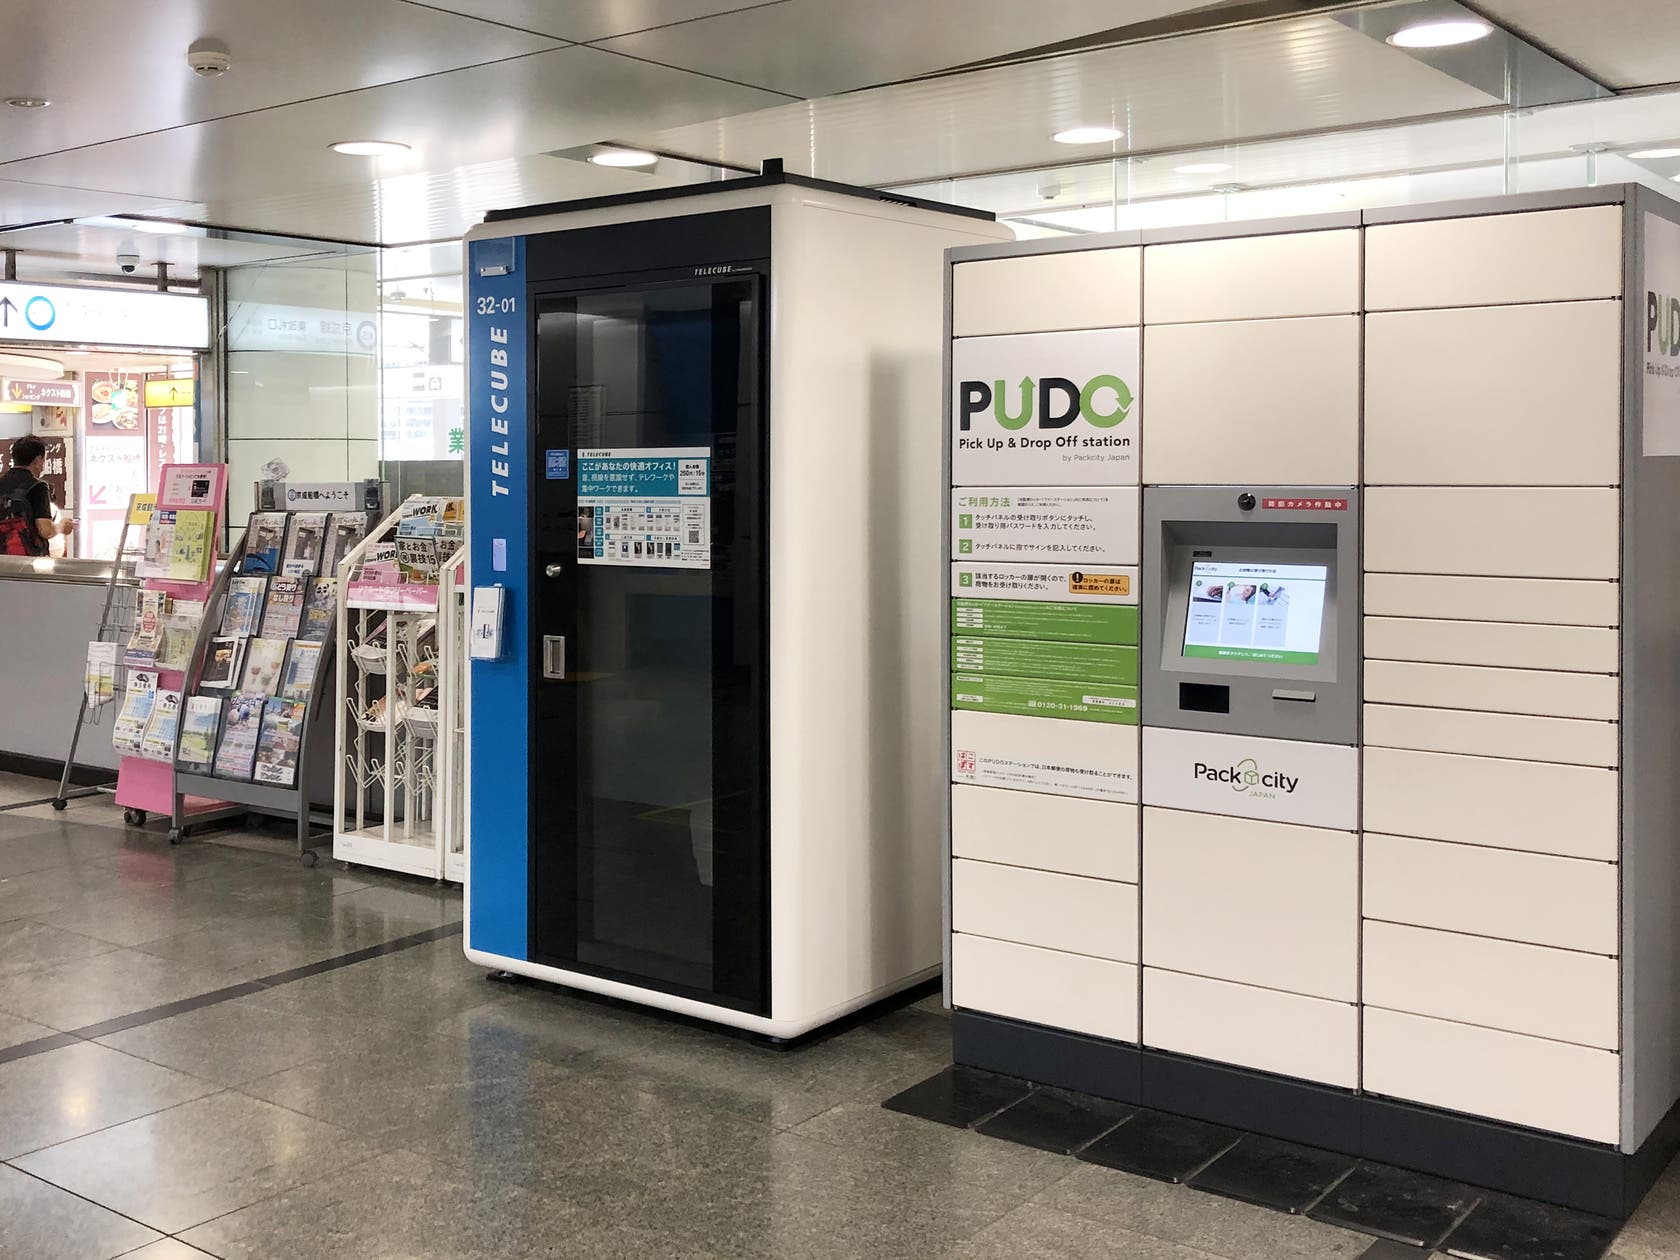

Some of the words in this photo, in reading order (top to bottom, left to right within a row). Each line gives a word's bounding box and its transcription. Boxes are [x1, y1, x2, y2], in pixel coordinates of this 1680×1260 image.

[694, 265, 732, 276] TELECUBE
[476, 295, 516, 315] 32-01
[959, 374, 1135, 431] PUDO
[490, 326, 510, 497] TELECUBE
[959, 438, 983, 449] Pick
[987, 438, 1004, 451] Up
[1007, 437, 1017, 448] &
[1020, 437, 1051, 450] Drop
[1055, 435, 1079, 448] Off
[1082, 436, 1131, 448] station
[1062, 454, 1072, 463] by
[1073, 453, 1105, 463] Packcity
[1107, 453, 1131, 463] Japan
[958, 496, 1011, 508] ご利用方法
[1248, 790, 1276, 800] JAPAN
